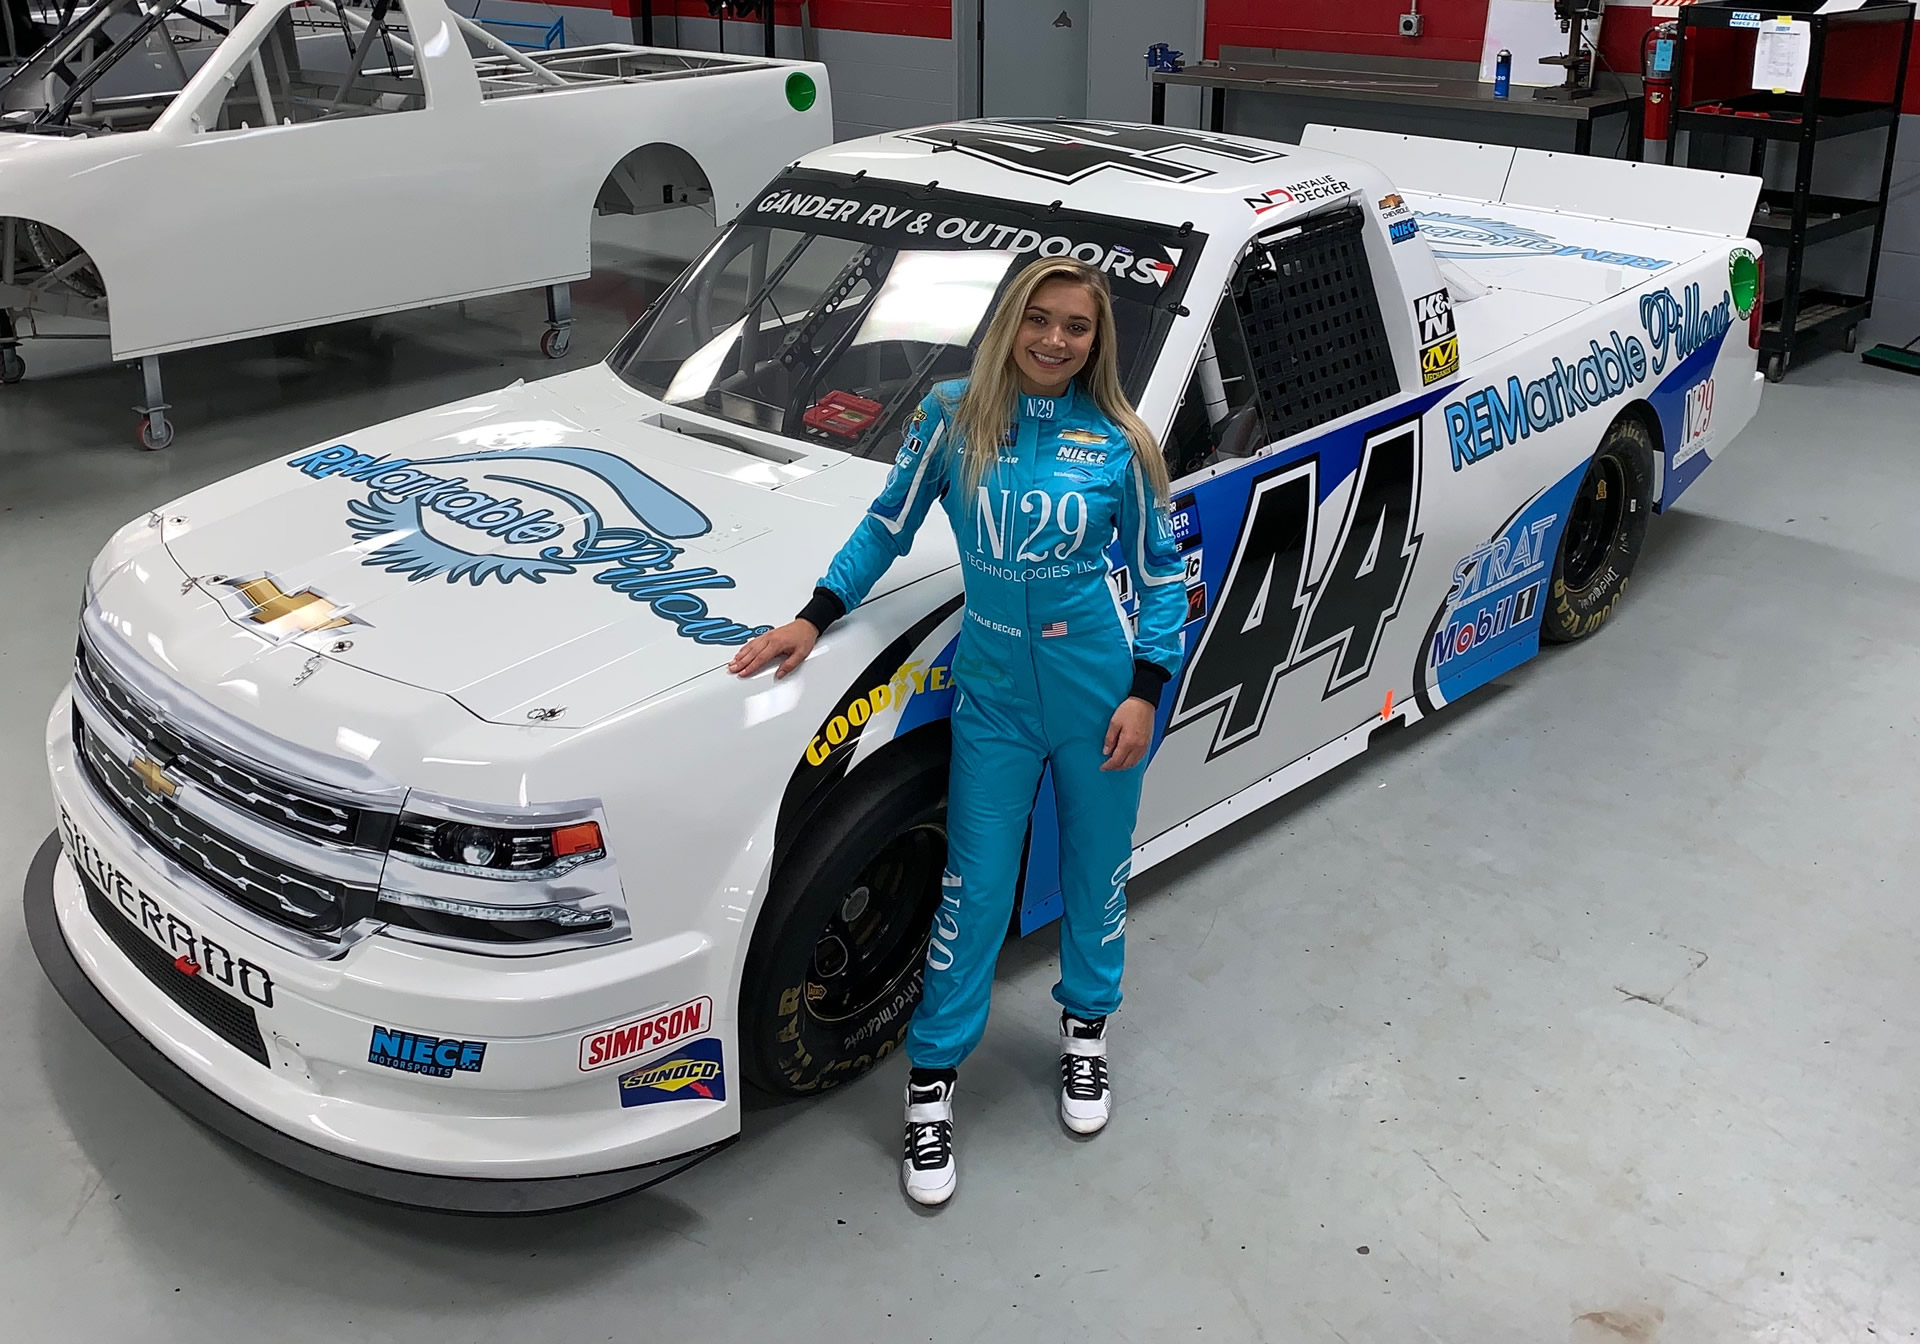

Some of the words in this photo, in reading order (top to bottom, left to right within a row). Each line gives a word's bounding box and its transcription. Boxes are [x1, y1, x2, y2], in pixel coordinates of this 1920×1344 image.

[1287, 175, 1336, 193] NATALIE
[1294, 181, 1350, 204] DECKER
[757, 191, 860, 223] GANDER
[857, 205, 911, 231] RV
[906, 211, 933, 236] &
[936, 217, 1160, 285] OUTDOORS
[1444, 330, 1648, 472] REMarkable
[1682, 379, 1715, 447] N29
[288, 444, 565, 544] REMarkable
[975, 486, 1089, 562] N29
[965, 551, 1070, 582] TECHNOLOGIES
[1077, 561, 1097, 575] LLC
[1162, 411, 1425, 764] 44
[1446, 513, 1558, 606] STRAT
[968, 608, 992, 629] NATALIE
[992, 622, 1022, 638] DECKER
[1430, 595, 1513, 668] Mobil
[60, 804, 275, 1008] SILVERADO
[369, 1053, 451, 1077] MOTORSPORTS
[588, 1002, 703, 1065] SIMPSON
[626, 1060, 718, 1088] SUNOCO
